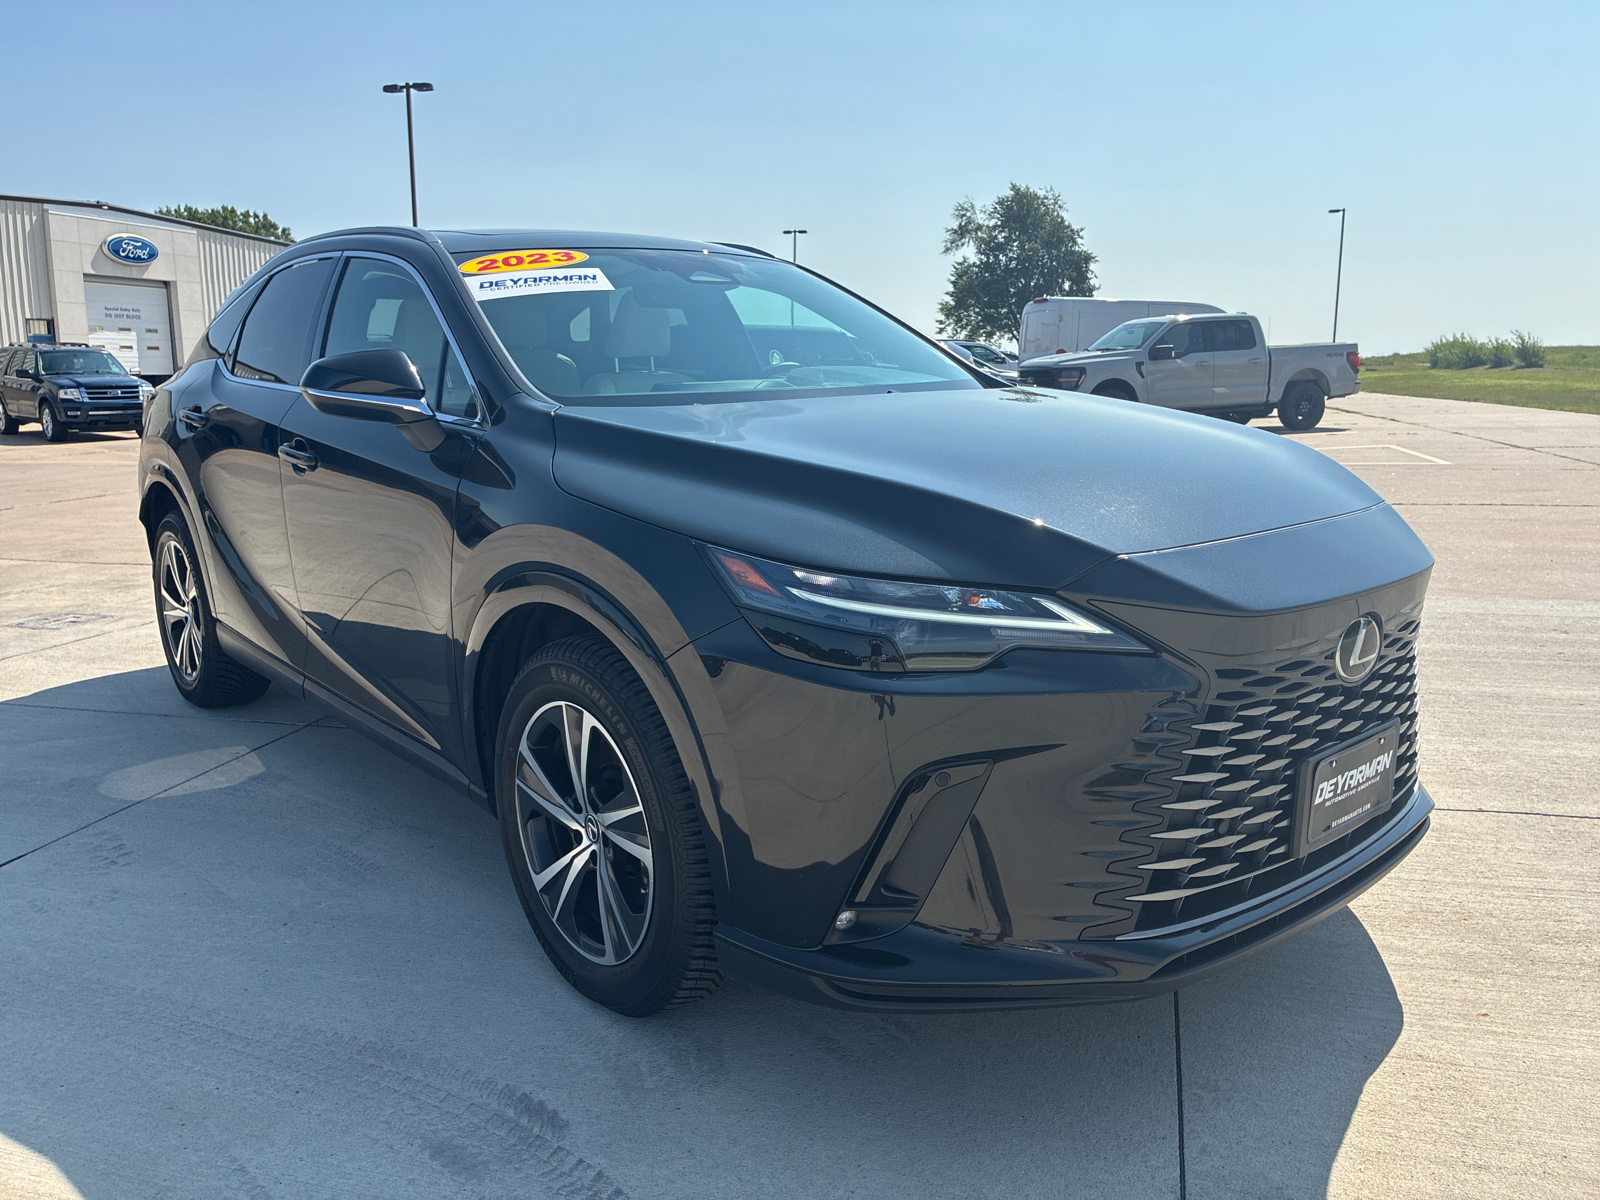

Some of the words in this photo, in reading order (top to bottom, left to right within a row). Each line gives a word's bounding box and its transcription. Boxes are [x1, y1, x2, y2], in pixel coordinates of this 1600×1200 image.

[119, 239, 150, 259] Ford
[476, 251, 576, 272] 2023
[479, 274, 597, 290] DEYARMAN
[489, 283, 540, 292] CERTIFIED
[570, 672, 628, 736] MICHELIN
[1314, 749, 1394, 806] DEYARMAN
